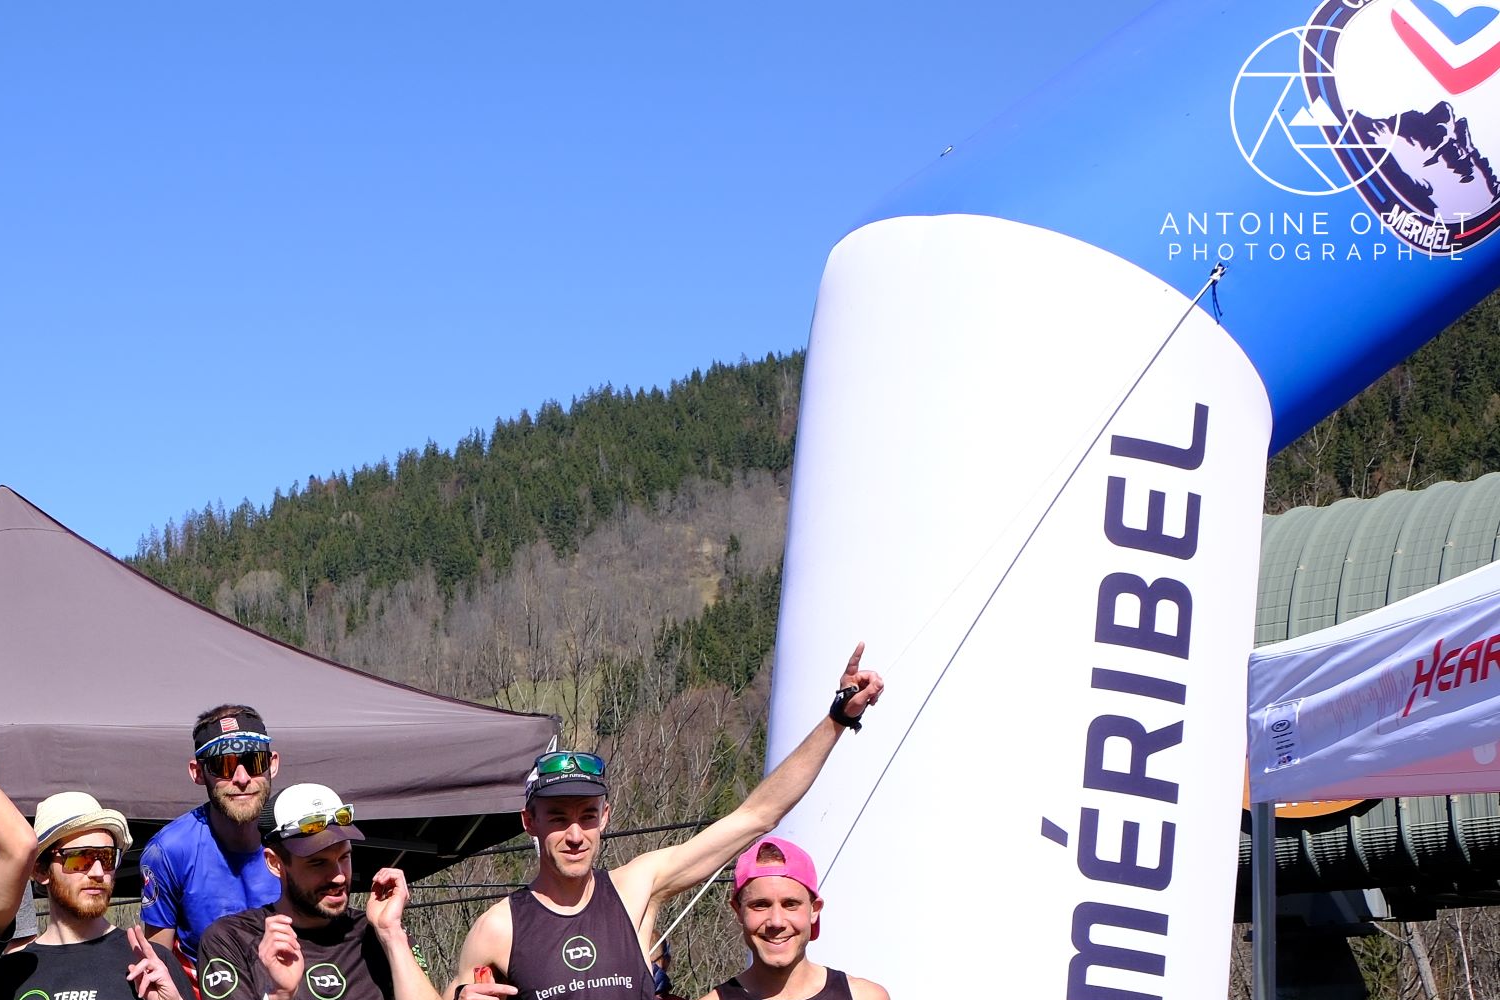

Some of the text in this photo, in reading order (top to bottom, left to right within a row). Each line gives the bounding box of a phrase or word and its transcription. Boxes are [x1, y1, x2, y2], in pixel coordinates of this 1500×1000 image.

[565, 946, 593, 960] TDR
[206, 970, 234, 988] TDR
[535, 973, 633, 1000] terre de running
